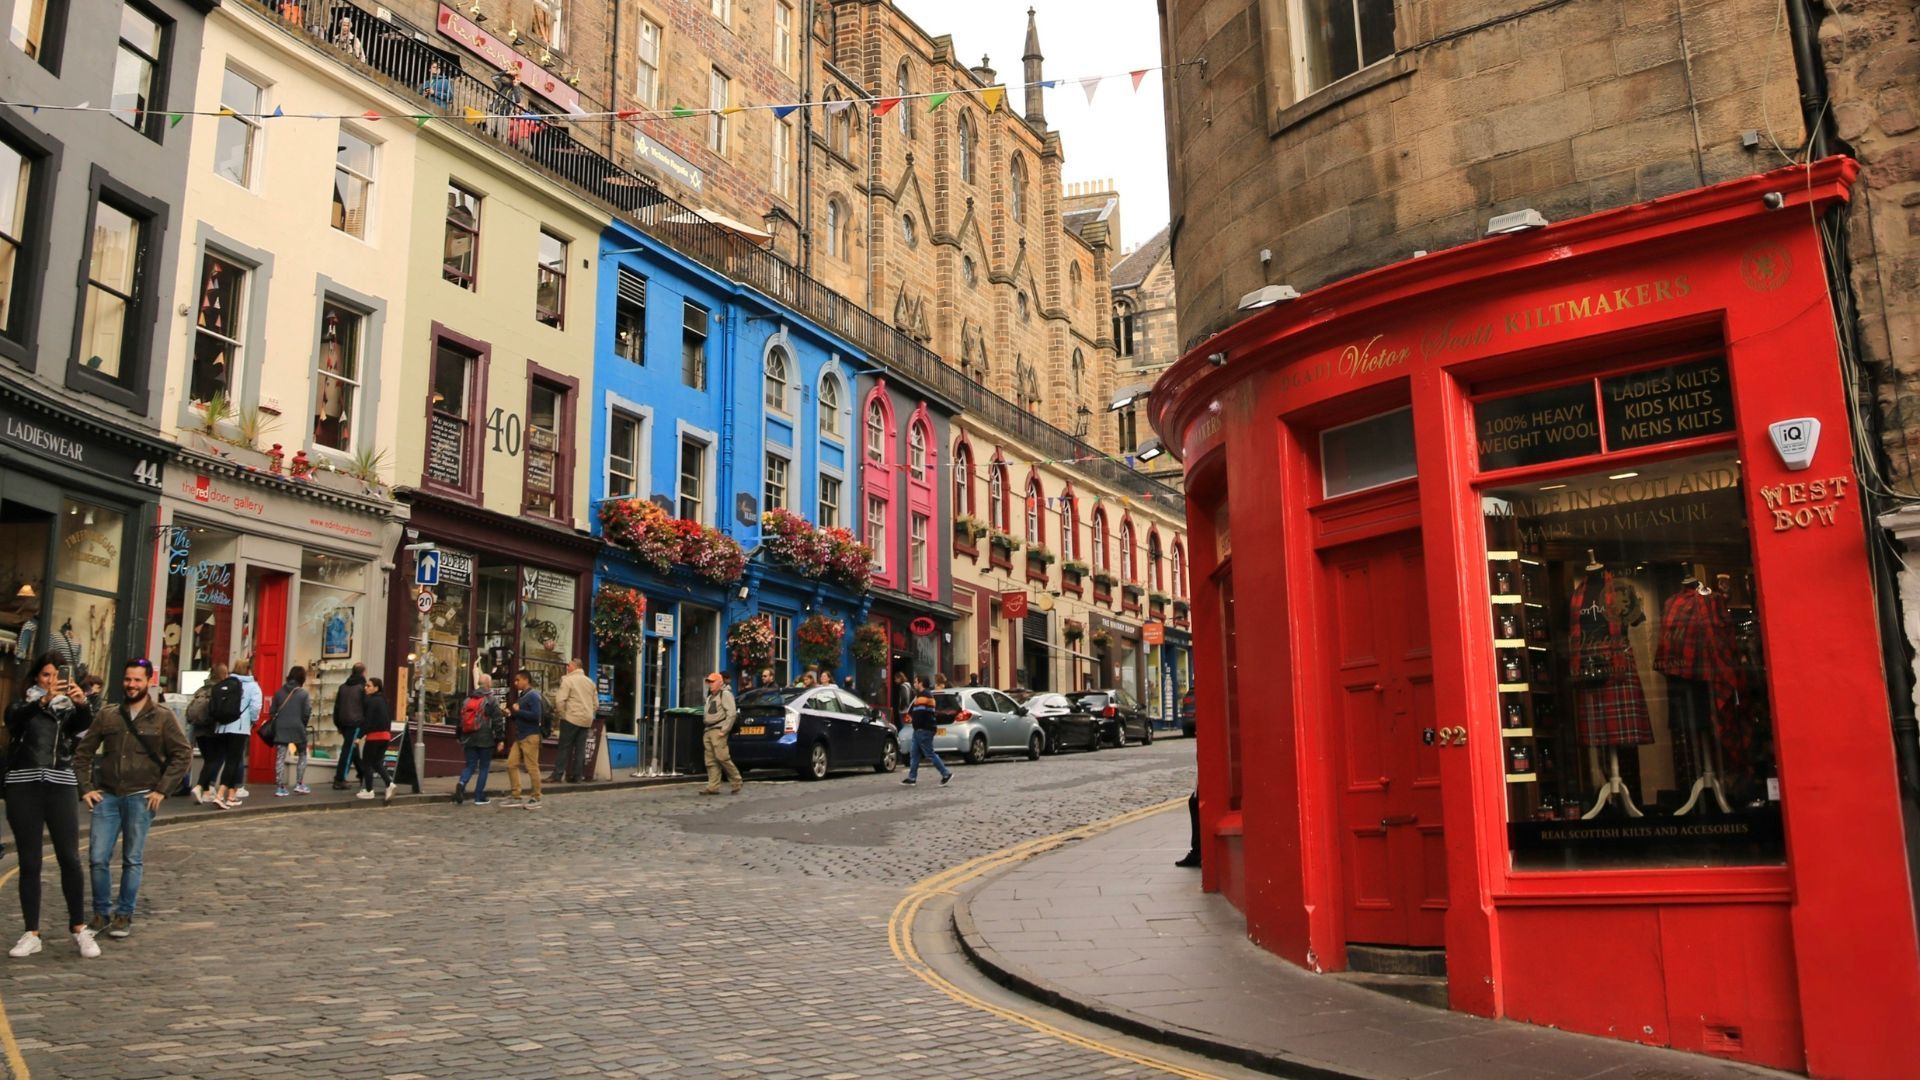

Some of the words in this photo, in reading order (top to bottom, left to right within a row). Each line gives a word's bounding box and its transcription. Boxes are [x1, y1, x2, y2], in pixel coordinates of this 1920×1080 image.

[1338, 334, 1411, 379] Victor
[1420, 318, 1494, 361] Scott
[1503, 273, 1693, 337] KILTMAKERS
[1613, 376, 1671, 402] LADIES
[1676, 367, 1722, 390] KILTS
[1485, 413, 1529, 436] 100%
[1531, 403, 1585, 428] HEAVY
[1624, 398, 1664, 420] KIDS
[1668, 389, 1713, 411] KILTS
[6, 417, 84, 462] LADIESWEAR
[487, 407, 521, 457] 40
[1477, 430, 1542, 456] WEIGHT
[1545, 420, 1600, 444] WOOL
[1620, 418, 1673, 442] MENS
[1677, 407, 1723, 432] KILTS
[1783, 426, 1802, 441] iQ
[182, 480, 196, 496] the
[196, 486, 209, 499] red
[210, 488, 231, 503] door
[233, 495, 264, 515] gallery
[1492, 494, 1564, 523] MADE
[1566, 487, 1593, 511] IN
[1599, 468, 1735, 507] SCOTLAND
[1760, 475, 1850, 510] WEST
[1613, 502, 1714, 531] MEASURE
[1772, 501, 1840, 531] BOW
[419, 597, 431, 607] 20
[1440, 725, 1467, 746] 92
[1541, 829, 1567, 840] REAL
[1568, 827, 1620, 840] SCOTTISH
[1622, 826, 1652, 838] KILTS
[1653, 825, 1678, 837] AND
[1680, 822, 1749, 836] ACCESORIES
